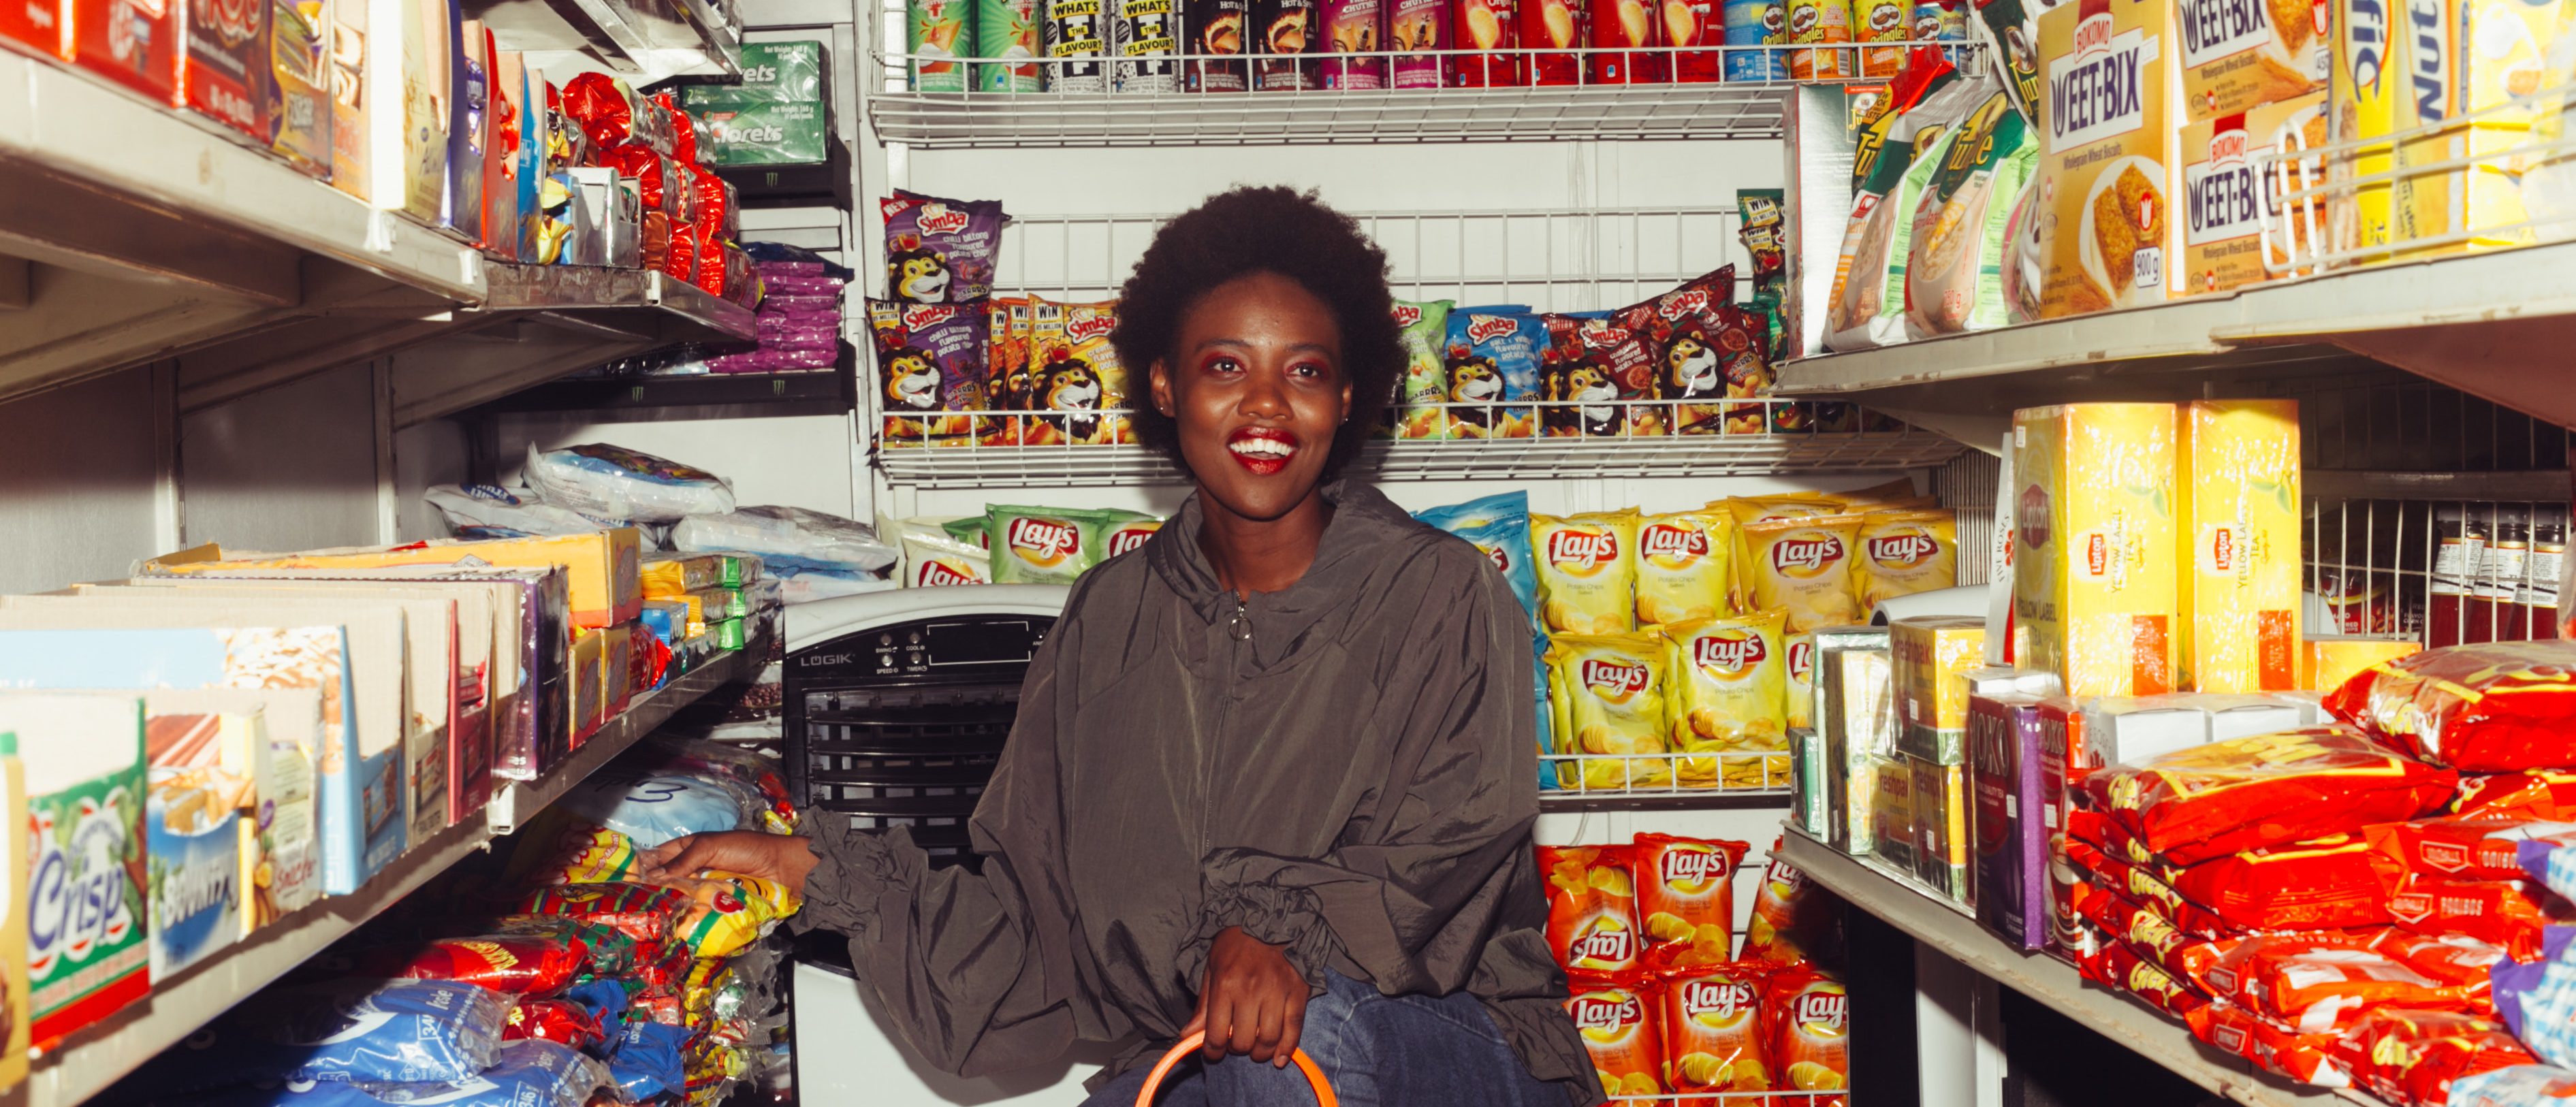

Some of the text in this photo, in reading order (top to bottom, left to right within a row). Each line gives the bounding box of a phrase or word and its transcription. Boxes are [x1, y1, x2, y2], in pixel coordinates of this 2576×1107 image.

[1054, 2, 1099, 16] WHAT'S
[1126, 1, 1171, 14] WHAT'S
[1055, 42, 1102, 55] FLAVOUR?
[1128, 39, 1174, 53] FLAVOUR?
[2077, 20, 2110, 54] BOKOMO
[2051, 46, 2140, 139] WEET-BIX
[710, 121, 783, 144] Clorets
[2212, 137, 2245, 163] BOKOMO
[883, 200, 909, 217] NEW
[1749, 199, 1770, 211] WIN
[920, 211, 966, 234] Simba
[2135, 253, 2159, 281] 900 g
[906, 306, 954, 330] Simba
[1015, 307, 1028, 317] WI
[1038, 306, 1058, 318] WIN
[1662, 291, 1704, 318] Simba
[1069, 316, 1116, 340] Simba
[1470, 317, 1515, 342] Simba
[2022, 499, 2048, 532] Lipton
[1012, 519, 1075, 559] Lay's
[1644, 526, 1704, 562] Lay's
[1997, 513, 2009, 554] ROSES
[2251, 536, 2259, 557] TEA
[1553, 531, 1613, 569] Lay's
[1778, 539, 1837, 570] Lay's
[1875, 534, 1930, 564] Lay's
[2091, 536, 2105, 574] Lipton
[2217, 531, 2230, 568] Lipton
[2238, 545, 2247, 589] YELLOW
[801, 654, 851, 667] LOGIK
[1704, 637, 1759, 672] Lay's
[1589, 659, 1645, 697] Lay's
[1977, 713, 2008, 777] OKO
[1666, 850, 1723, 886] Lay's
[1690, 982, 1750, 1018] Lay's
[1799, 994, 1845, 1029] Lay
[1577, 999, 1635, 1033] Lay's
